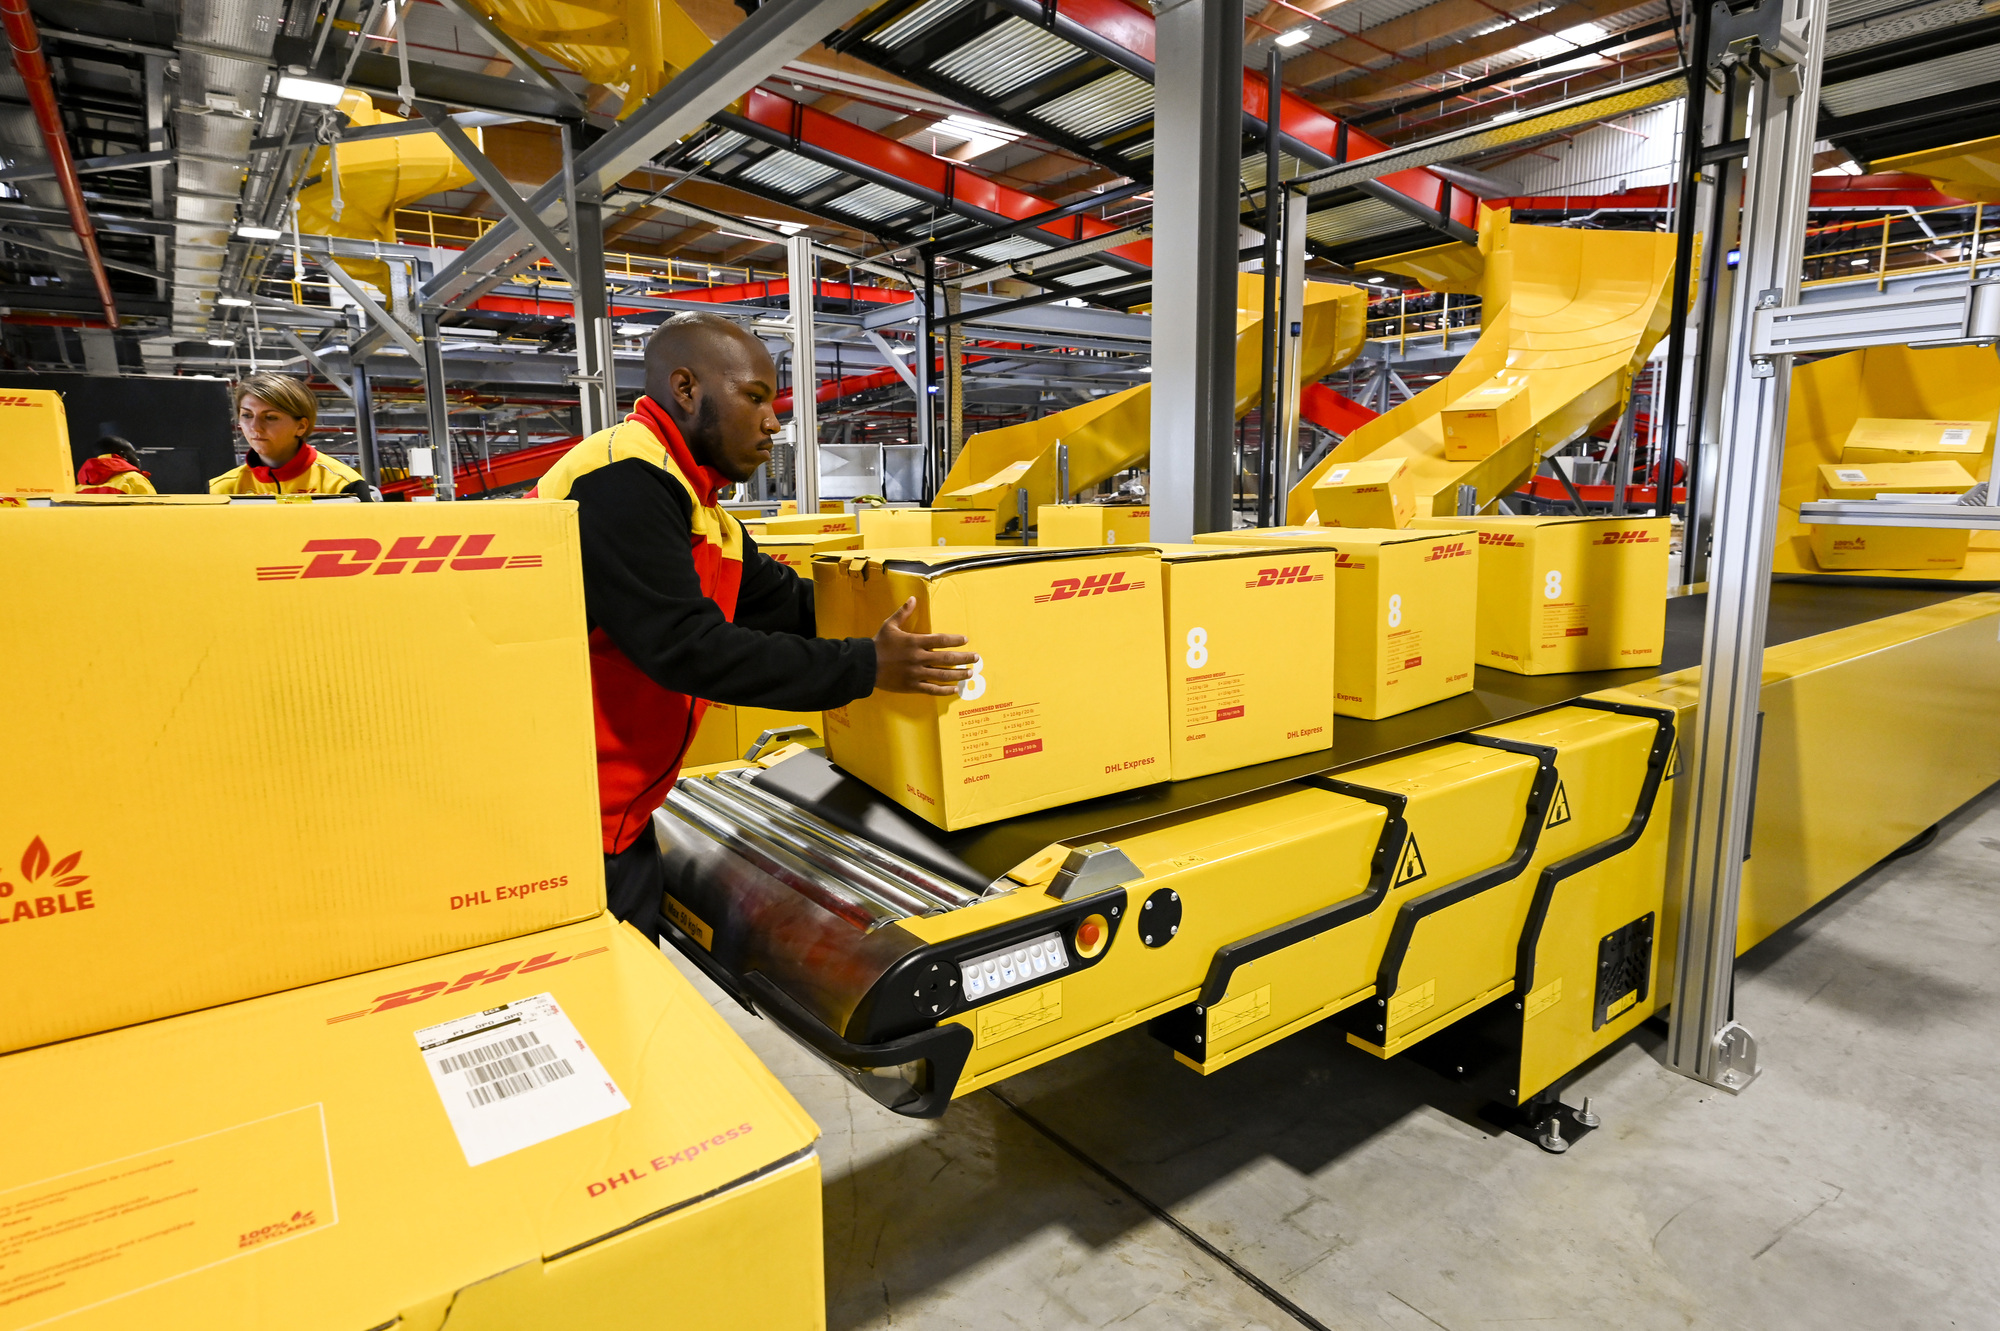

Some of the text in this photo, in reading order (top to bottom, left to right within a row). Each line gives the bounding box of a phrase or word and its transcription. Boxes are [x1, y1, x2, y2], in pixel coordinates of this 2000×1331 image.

[0, 396, 32, 406] HL
[822, 523, 848, 532] DHL
[964, 516, 987, 524] DHL
[1107, 530, 1116, 545] 8
[1478, 532, 1517, 547] DHL
[1602, 530, 1651, 545] DHL
[300, 534, 509, 579] DHL
[1430, 542, 1466, 561] DHL
[1256, 565, 1315, 588] DHL
[1544, 570, 1562, 600] 8
[1048, 572, 1132, 602] DHL
[1388, 594, 1402, 628] 8
[1186, 627, 1209, 669] 8
[1491, 650, 1519, 661] DHL Express
[956, 652, 987, 701] 8
[1454, 672, 1468, 682] Express
[1337, 693, 1363, 702] Express
[959, 702, 1014, 717] RECOMMENDED WEIGHT
[1186, 733, 1206, 742] dhl.com
[1287, 726, 1323, 740] DHL Express
[1105, 756, 1156, 775] DHL Express
[964, 774, 990, 785] dhl.com
[906, 784, 935, 806] DHL Express
[450, 874, 569, 911] DHL Express
[668, 901, 680, 919] Max
[680, 911, 688, 926] 50
[366, 951, 575, 1015] DHL
[475, 1020, 495, 1029] OPO
[504, 1011, 523, 1021] OPO
[586, 1122, 753, 1198] DHL Express
[240, 1221, 289, 1242] 100%
